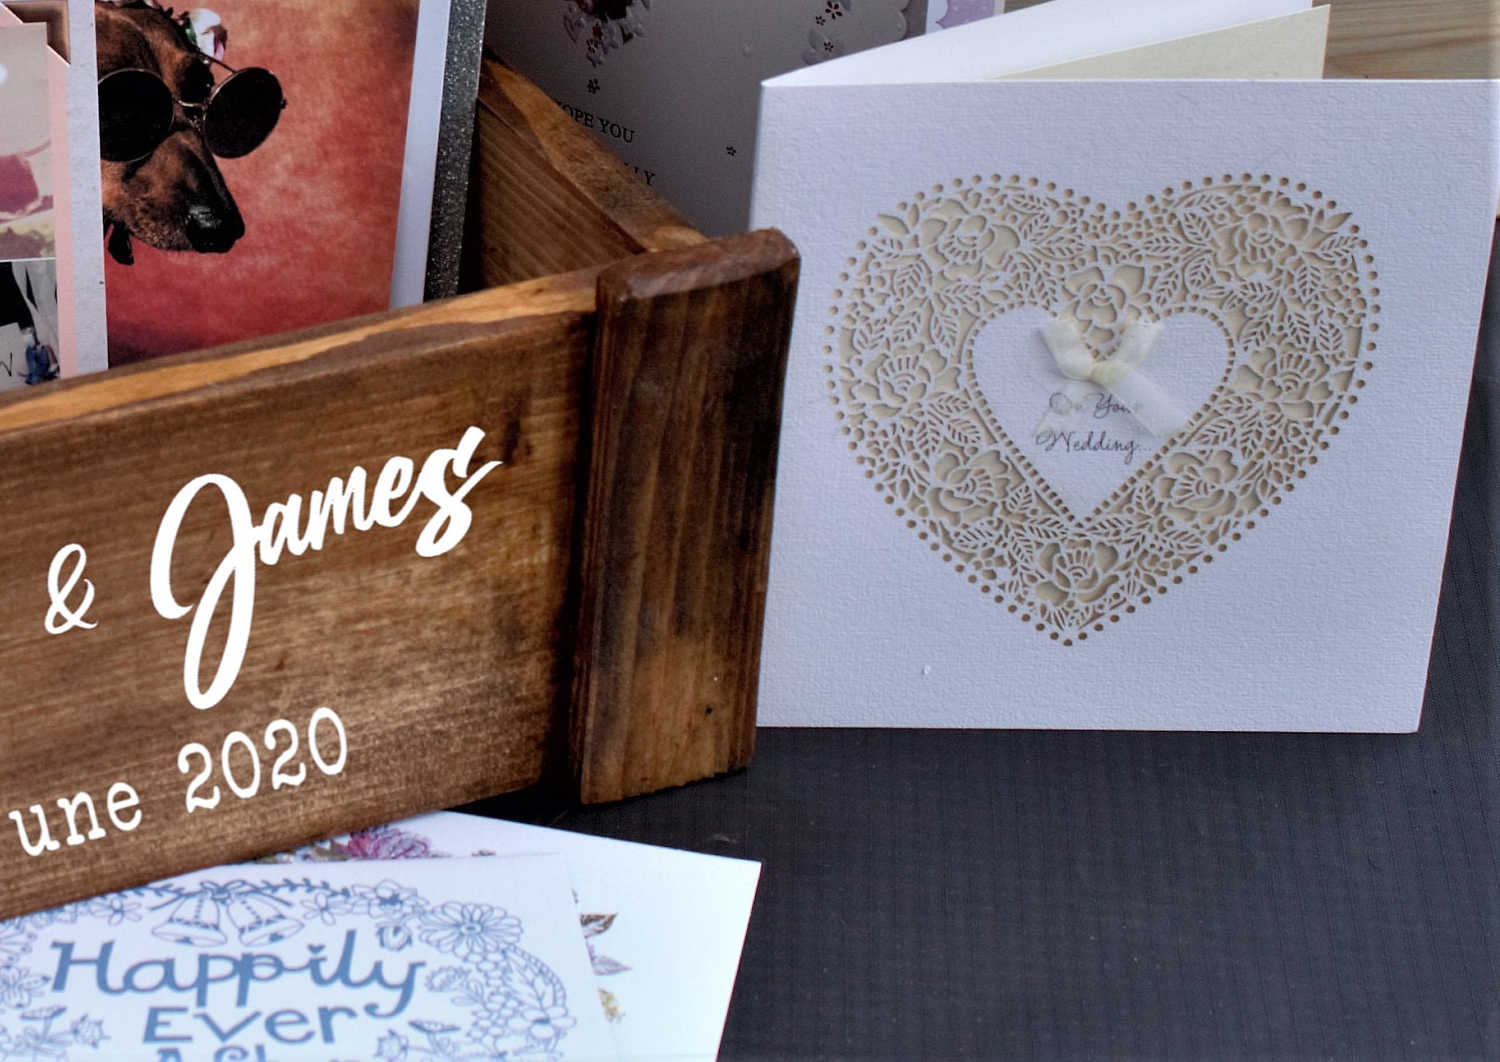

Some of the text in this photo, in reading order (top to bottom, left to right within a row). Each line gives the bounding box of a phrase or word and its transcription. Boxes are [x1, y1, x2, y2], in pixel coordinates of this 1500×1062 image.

[556, 100, 636, 143] OPE YOU
[44, 543, 99, 635] &
[150, 426, 504, 710] James
[177, 706, 349, 814] 2020
[48, 930, 426, 1018] Happily
[141, 1005, 359, 1045] Ever
